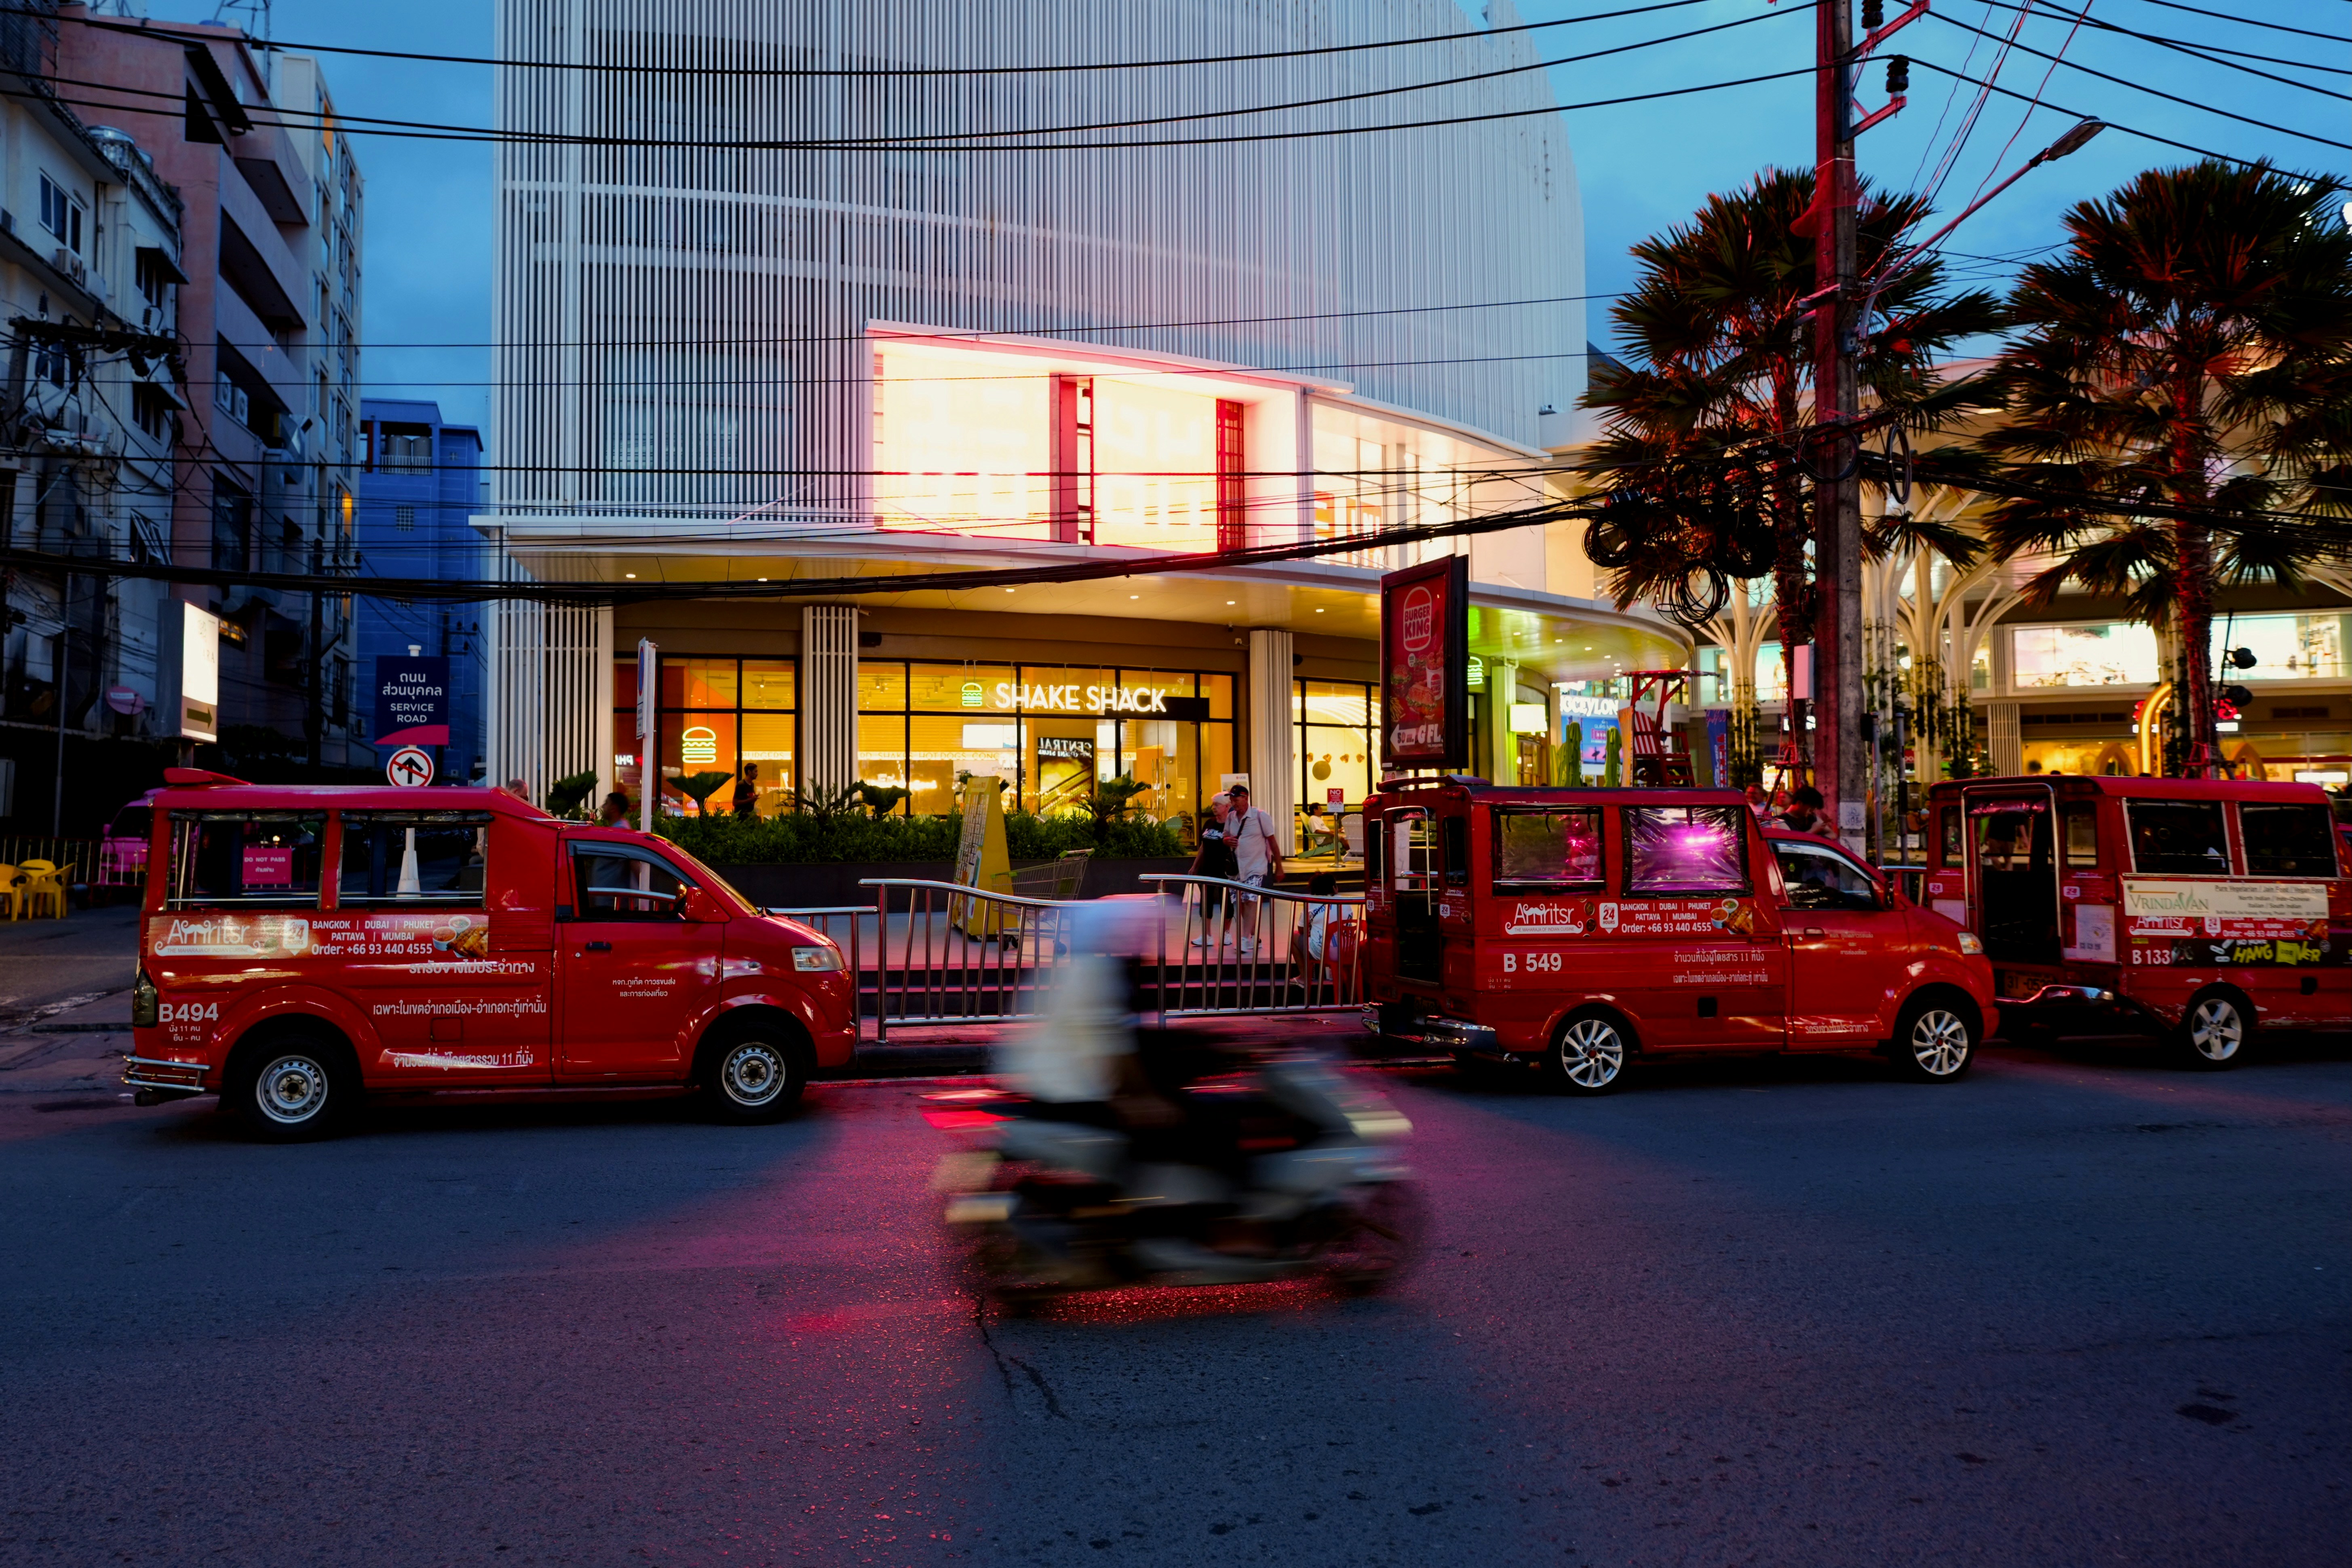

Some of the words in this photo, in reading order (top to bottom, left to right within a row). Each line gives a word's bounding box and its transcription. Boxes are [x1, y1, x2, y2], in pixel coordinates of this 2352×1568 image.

[1405, 605, 1430, 622] BURGER
[1405, 618, 1430, 639] KING
[400, 673, 426, 682] ถนน
[382, 682, 442, 699] ส่วนบุคคล
[995, 683, 1080, 710] SHAKE
[1086, 686, 1167, 713] SHACK
[390, 703, 434, 711] SERVICE
[1514, 903, 1574, 924] Amritsr
[1603, 909, 1615, 920] 24
[167, 919, 250, 944] Amritsr
[312, 921, 350, 929] BANGKOK
[365, 921, 389, 929] DUBAI
[404, 920, 434, 929] PHUKET
[1622, 924, 1646, 933] Order:
[1647, 923, 1662, 932] +66
[1664, 923, 1673, 932] 93
[1675, 923, 1690, 932] 440
[1692, 922, 1711, 931] 4555
[312, 944, 344, 955] Order:
[347, 945, 365, 955] +66
[369, 944, 382, 954] 93
[385, 944, 404, 954] 440
[407, 944, 432, 954] 4555
[1741, 953, 1748, 961] 11
[1751, 947, 1764, 961] ที่นั่ง
[2132, 950, 2142, 964] B
[2145, 950, 2171, 964] 133
[2232, 944, 2274, 963] HANG
[1504, 954, 1517, 972] B
[1526, 953, 1561, 972] 549
[620, 987, 668, 997] และการท่องเที่ยว
[159, 1003, 218, 1022] B494
[169, 1022, 177, 1032] นั่ง
[502, 1053, 512, 1064] 11
[515, 1046, 533, 1064] ที่นั่ง
